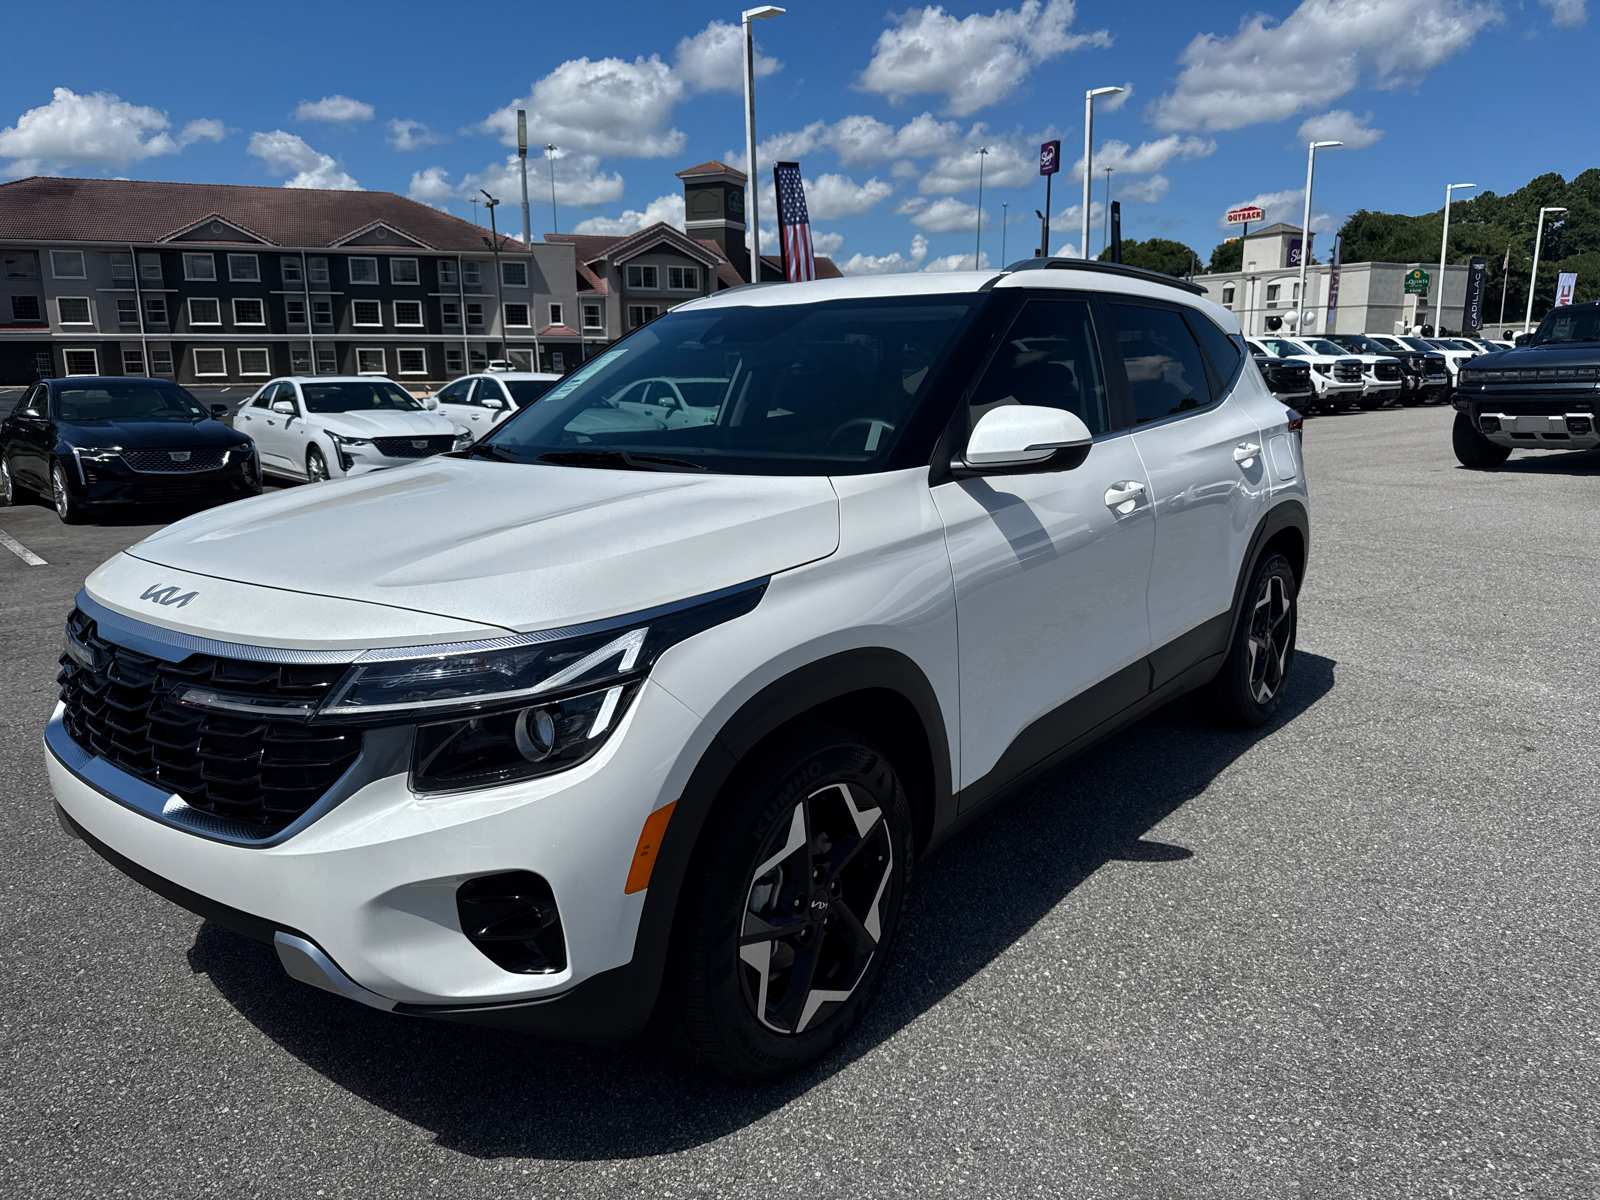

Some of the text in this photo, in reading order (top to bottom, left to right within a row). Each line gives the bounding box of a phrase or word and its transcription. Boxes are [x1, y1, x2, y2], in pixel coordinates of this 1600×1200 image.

[1228, 211, 1261, 222] OUTBACK
[1471, 273, 1481, 327] CADILLAC
[139, 582, 200, 608] KIA
[752, 761, 823, 841] KUMHO
